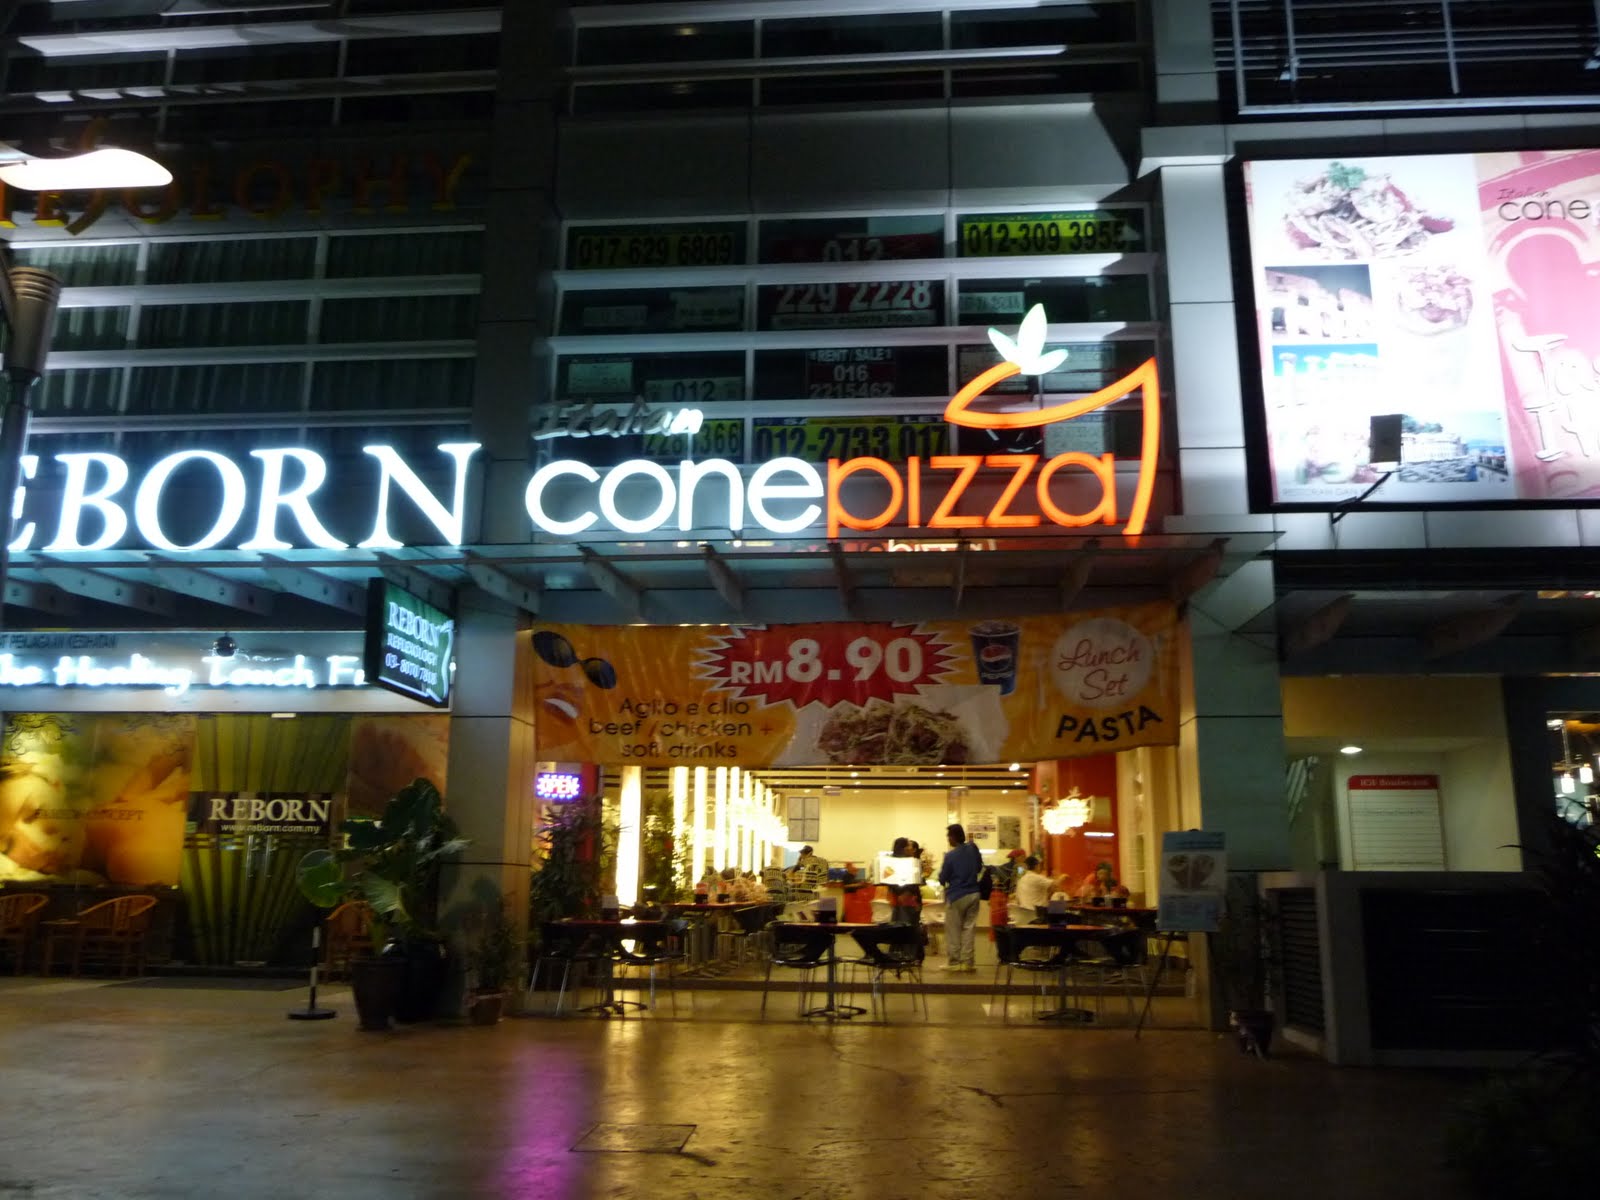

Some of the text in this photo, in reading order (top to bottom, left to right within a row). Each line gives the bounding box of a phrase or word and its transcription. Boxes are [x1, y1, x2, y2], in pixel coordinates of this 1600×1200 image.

[1498, 199, 1600, 224] cone
[833, 365, 869, 382] 016
[673, 381, 714, 401] 012
[388, 602, 439, 648] REBORN
[1057, 639, 1140, 671] Lunch
[1080, 668, 1128, 700] Set
[687, 702, 699, 715] e
[588, 718, 642, 736] beef
[660, 719, 752, 737] chicken
[1056, 705, 1163, 743] PASTA
[668, 741, 737, 758] drinks
[539, 777, 578, 795] OPEN
[208, 798, 331, 823] REBORN
